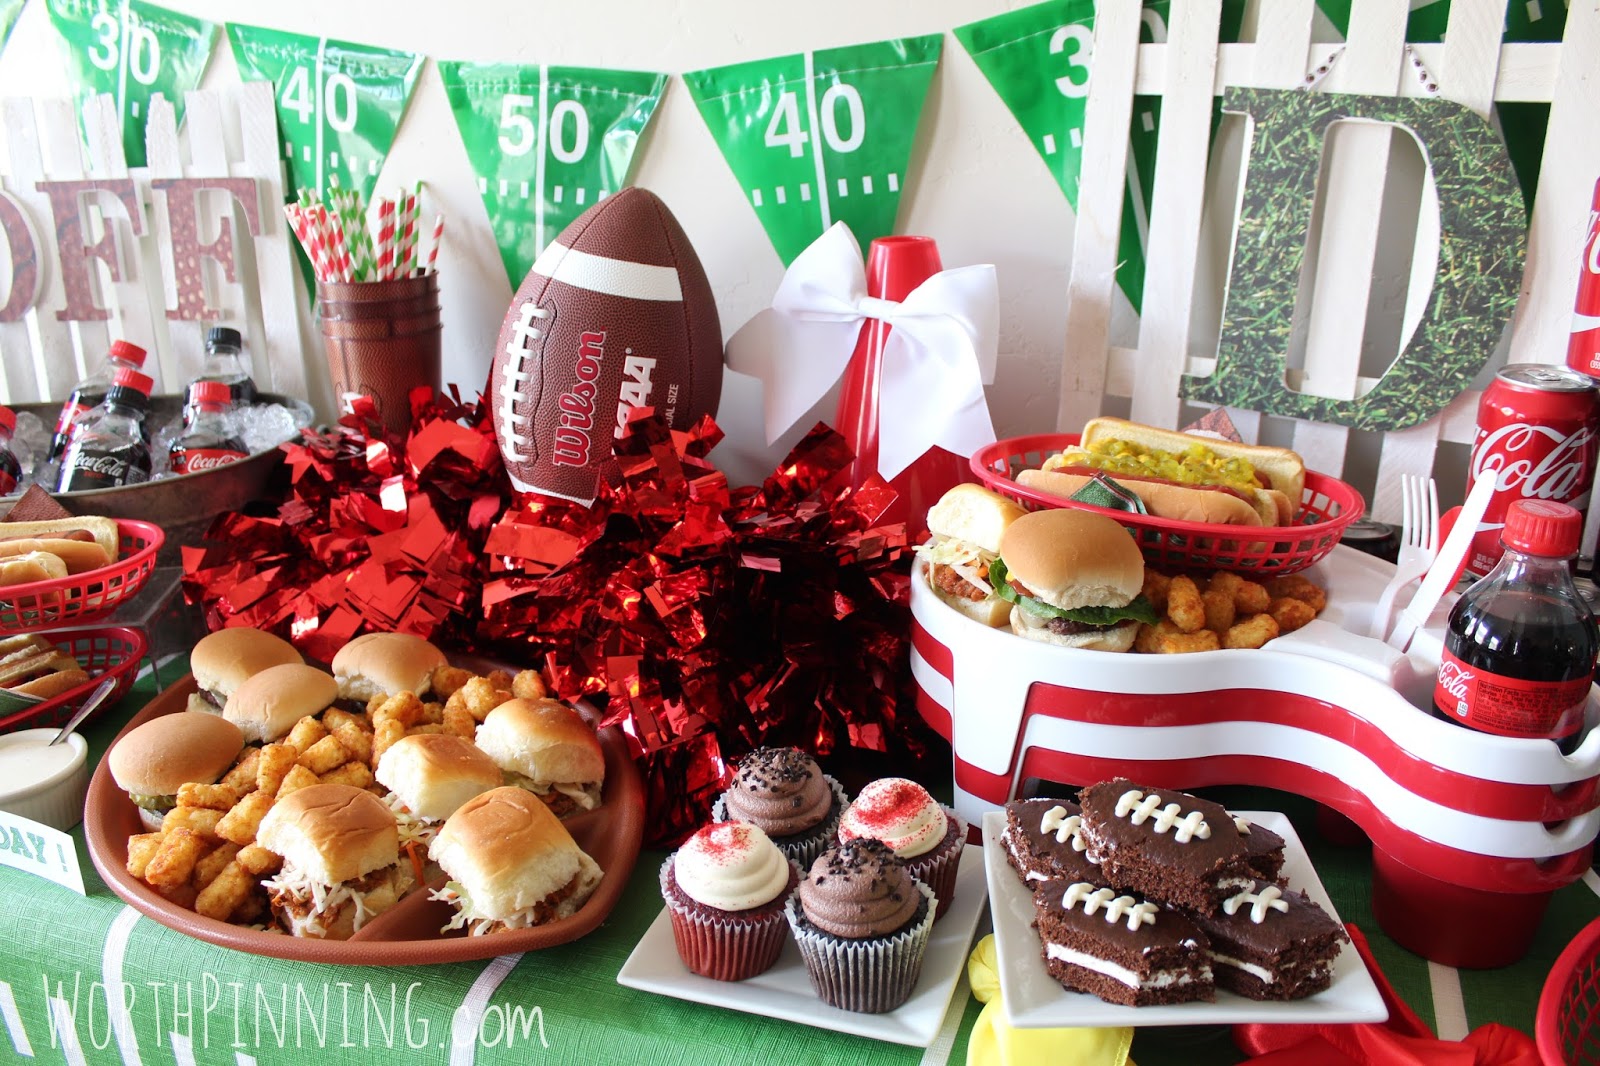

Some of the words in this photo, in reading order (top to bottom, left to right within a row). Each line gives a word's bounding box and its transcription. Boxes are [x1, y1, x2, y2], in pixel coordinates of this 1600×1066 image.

[1180, 86, 1528, 432] D
[553, 331, 604, 467] Wilson
[667, 383, 679, 404] SIZE
